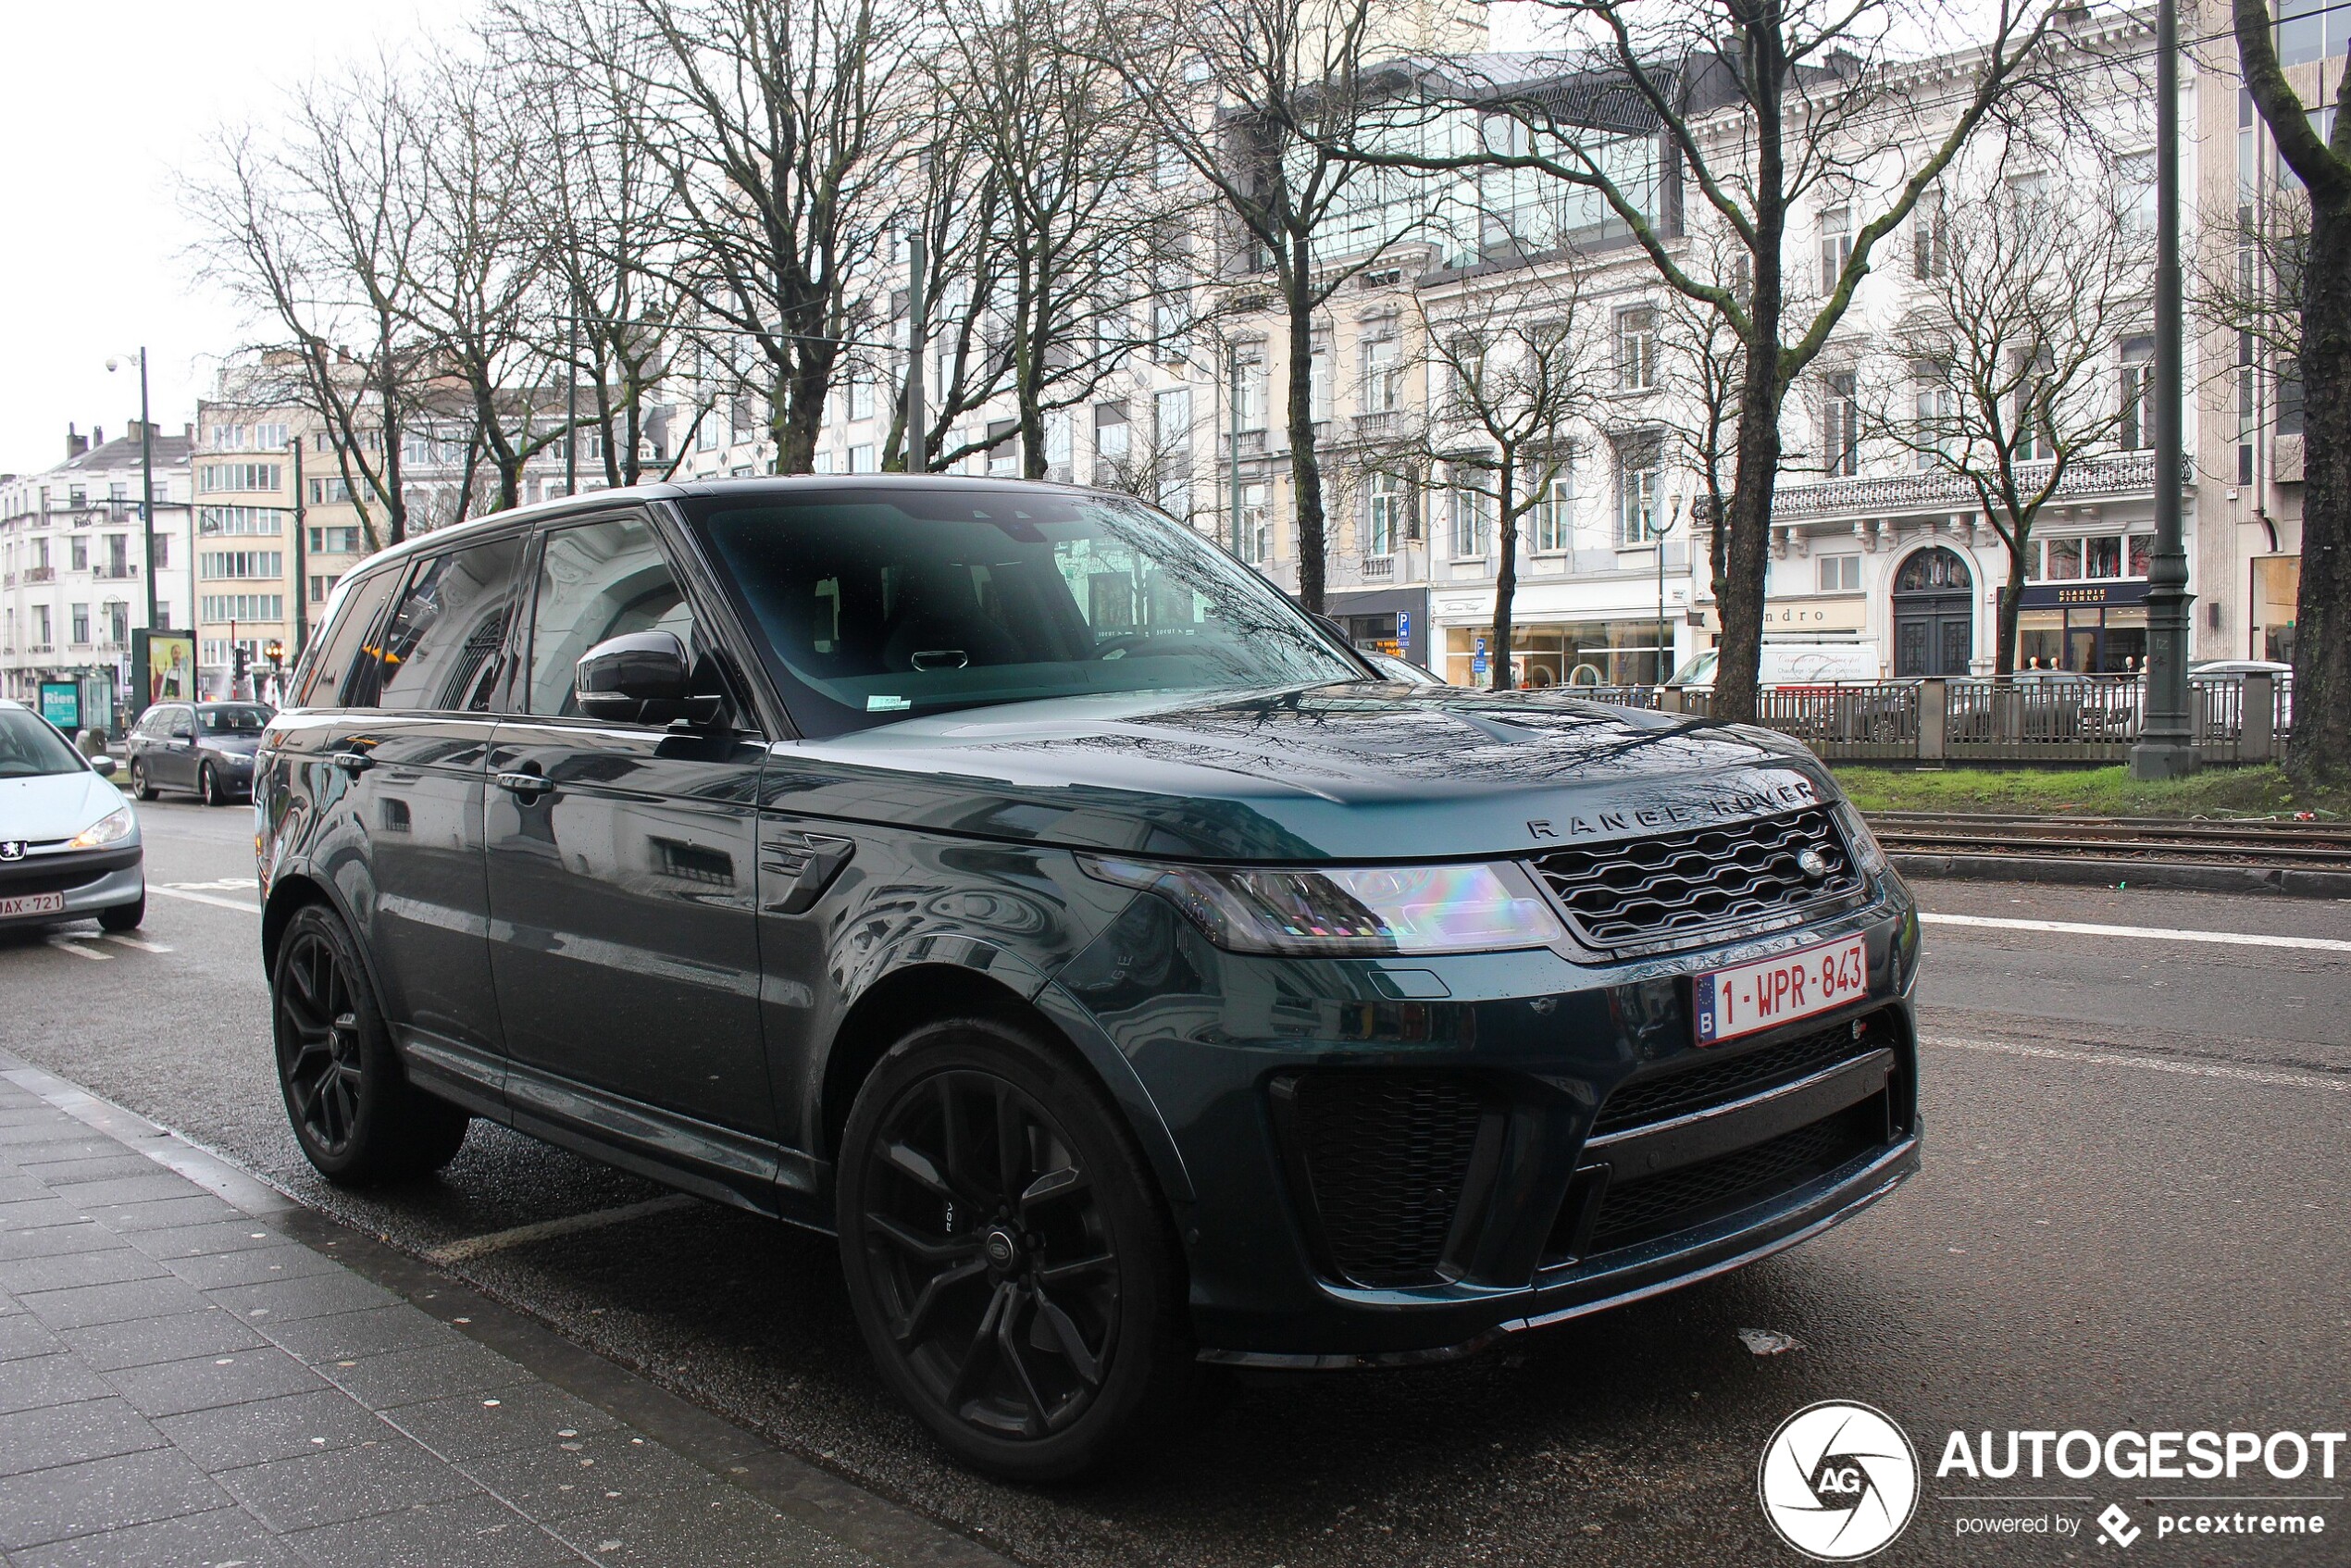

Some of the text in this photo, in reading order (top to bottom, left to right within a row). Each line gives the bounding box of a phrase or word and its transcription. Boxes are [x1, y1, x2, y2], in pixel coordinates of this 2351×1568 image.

[1400, 614, 1407, 628] P
[1765, 609, 1823, 622] ndro
[1477, 641, 1484, 655] P
[44, 691, 76, 704] Rien
[1527, 782, 1816, 840] RANGE ROVER
[1723, 946, 1861, 1025] 1-WPR-843
[1700, 1013, 1712, 1034] B
